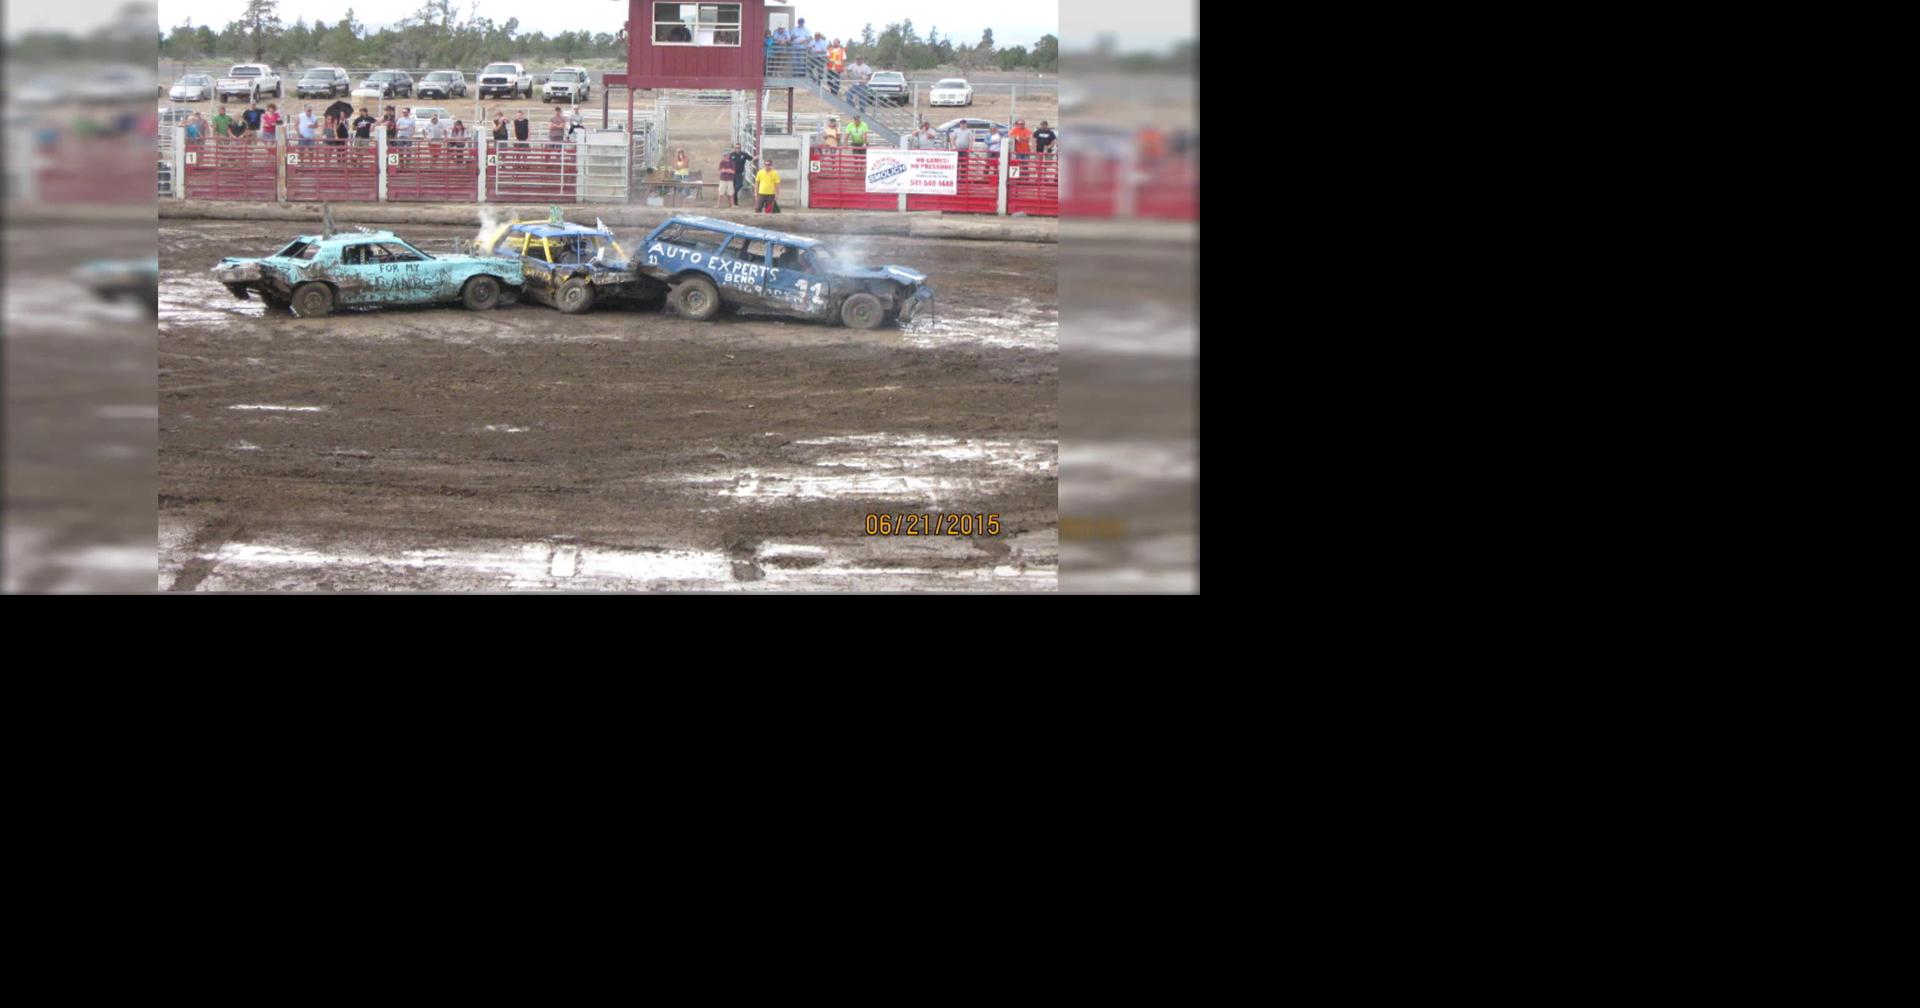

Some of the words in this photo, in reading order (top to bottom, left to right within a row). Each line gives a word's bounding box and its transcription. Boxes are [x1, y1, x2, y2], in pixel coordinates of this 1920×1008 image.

[289, 154, 296, 163] 2
[390, 155, 397, 164] 3
[489, 155, 496, 164] 4
[812, 162, 819, 171] 5
[868, 163, 906, 183] SMOLICH
[1011, 168, 1018, 177] 7
[647, 242, 701, 263] AUTO
[380, 264, 399, 273] FOR
[405, 263, 420, 272] MY
[724, 273, 755, 286] BEND
[794, 279, 824, 305] 11
